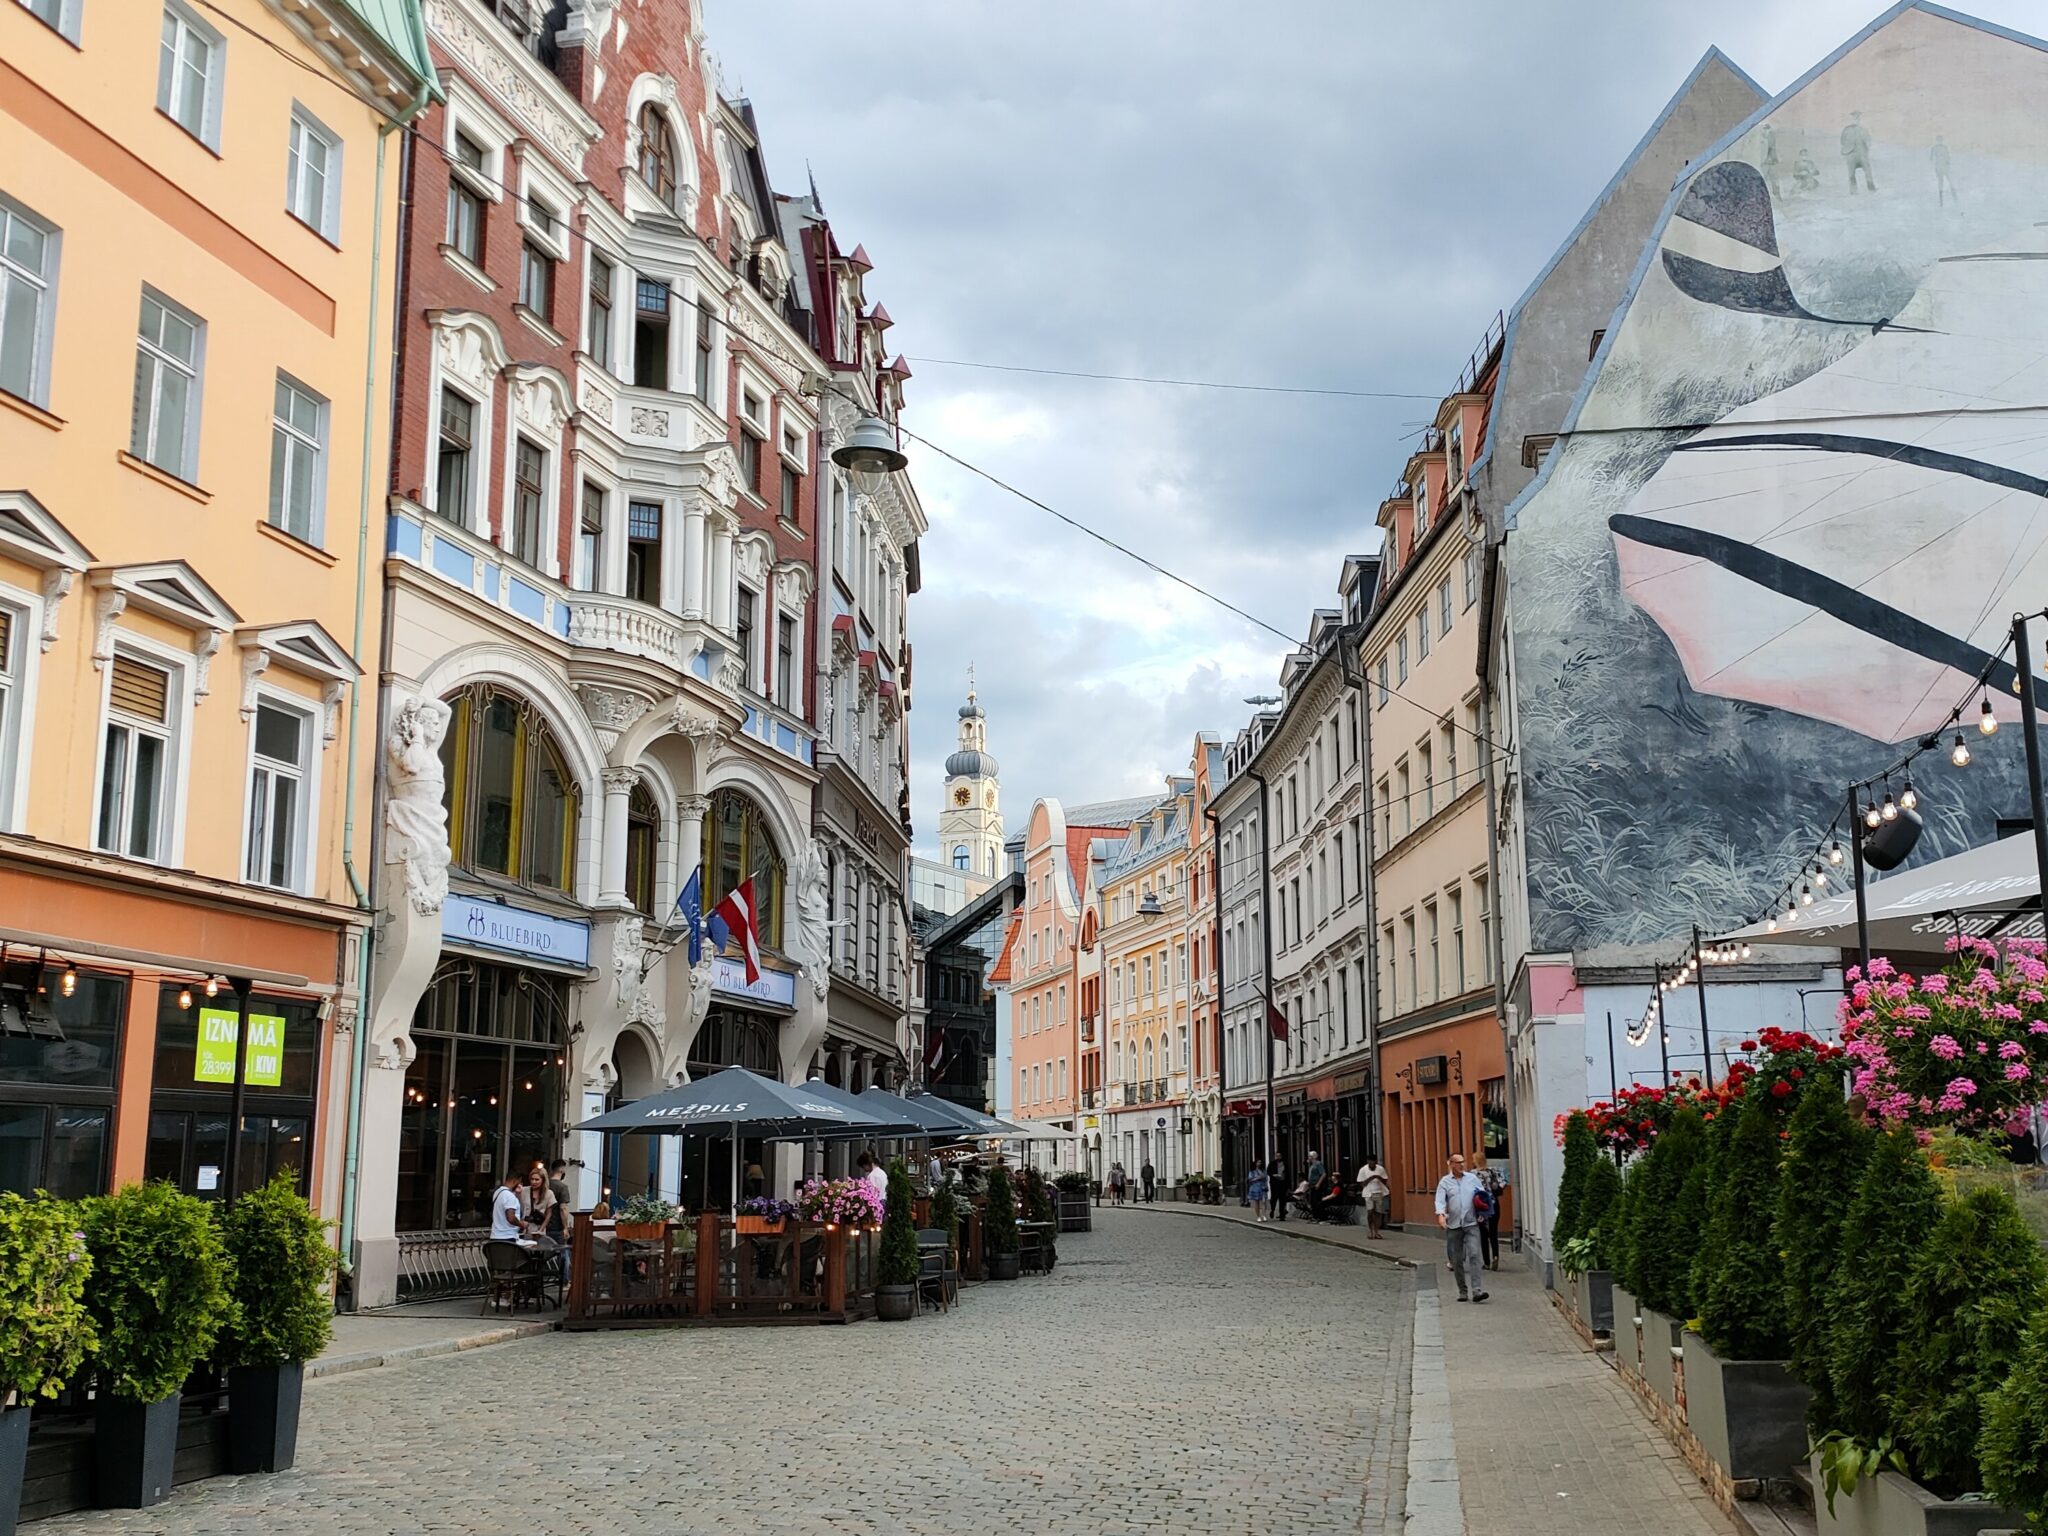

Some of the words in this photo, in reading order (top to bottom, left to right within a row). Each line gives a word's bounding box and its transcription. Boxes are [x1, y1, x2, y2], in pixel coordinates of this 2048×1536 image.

[491, 923, 551, 951] BLUEBIRD
[733, 976, 771, 998] BLUBIRD
[645, 1103, 749, 1117] MEŽPILS
